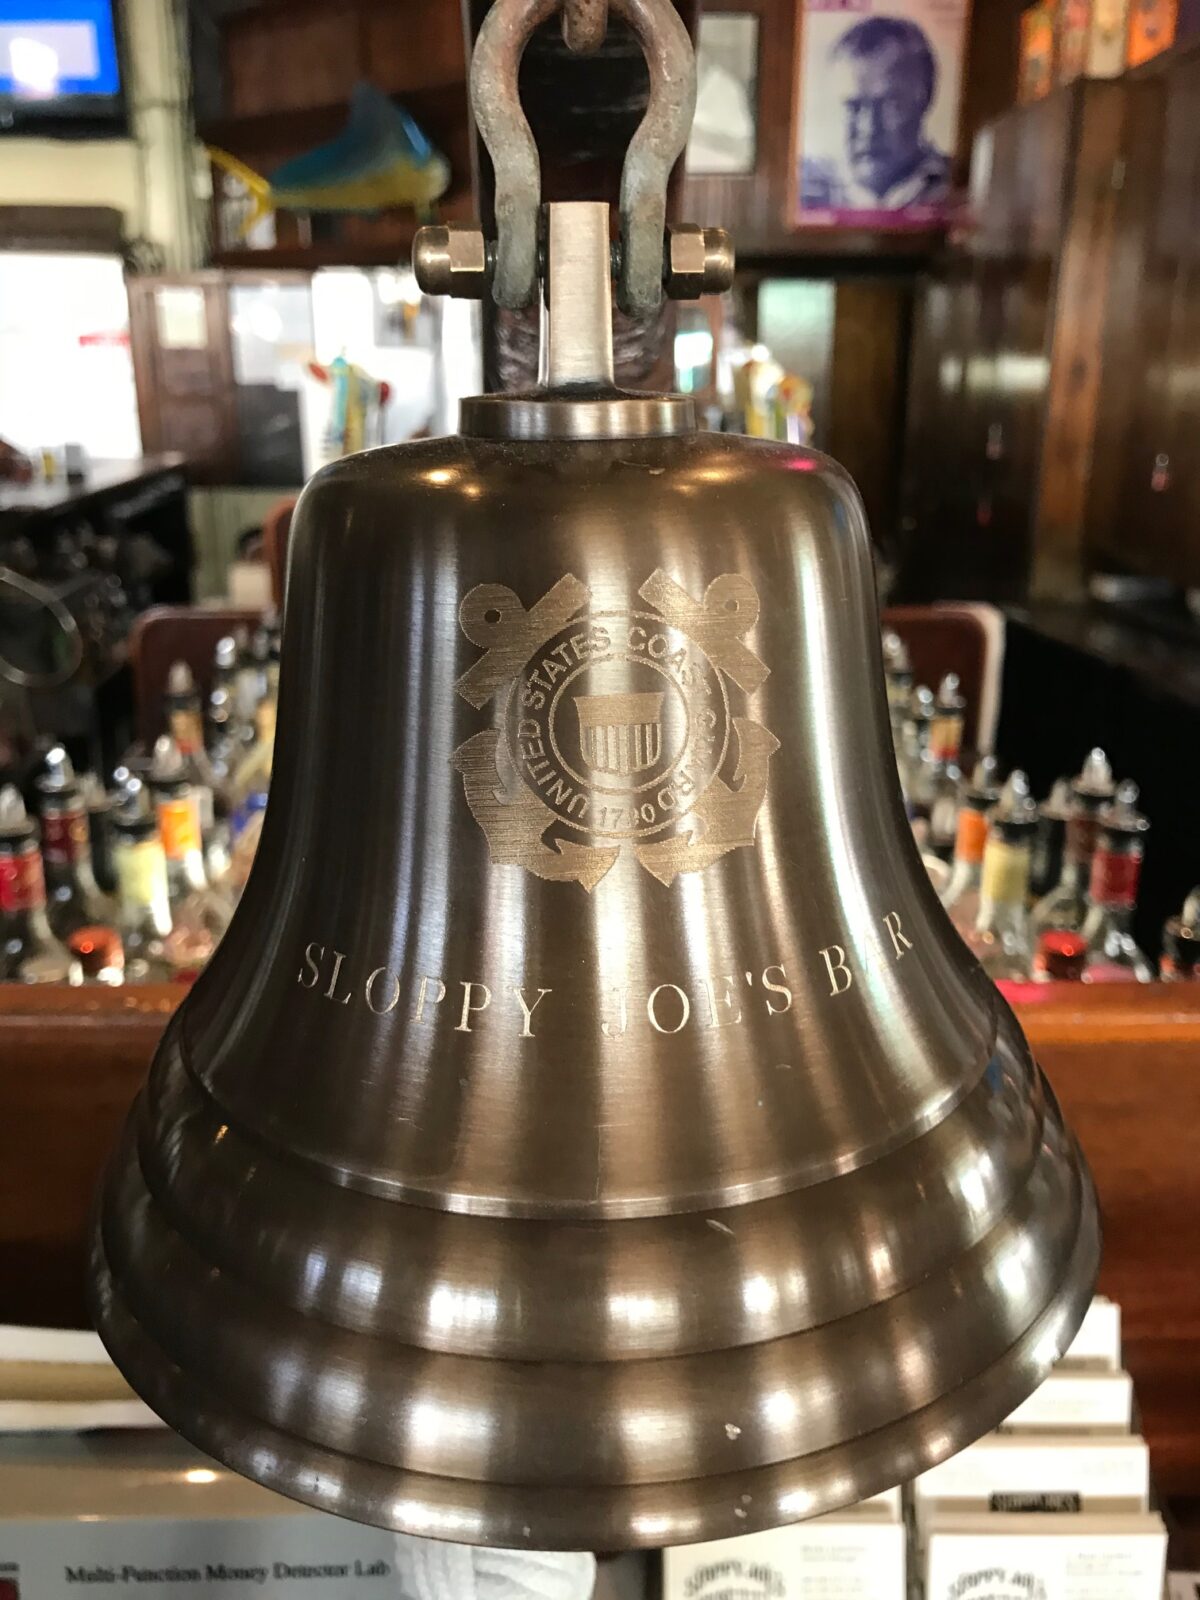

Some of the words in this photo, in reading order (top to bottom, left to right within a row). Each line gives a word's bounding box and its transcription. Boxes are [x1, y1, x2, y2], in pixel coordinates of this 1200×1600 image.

[521, 626, 611, 710] STATES
[517, 718, 590, 818] UNITED
[297, 942, 552, 1037] SLOPPY
[601, 963, 792, 1038] JOE'S
[819, 911, 913, 996] BR
